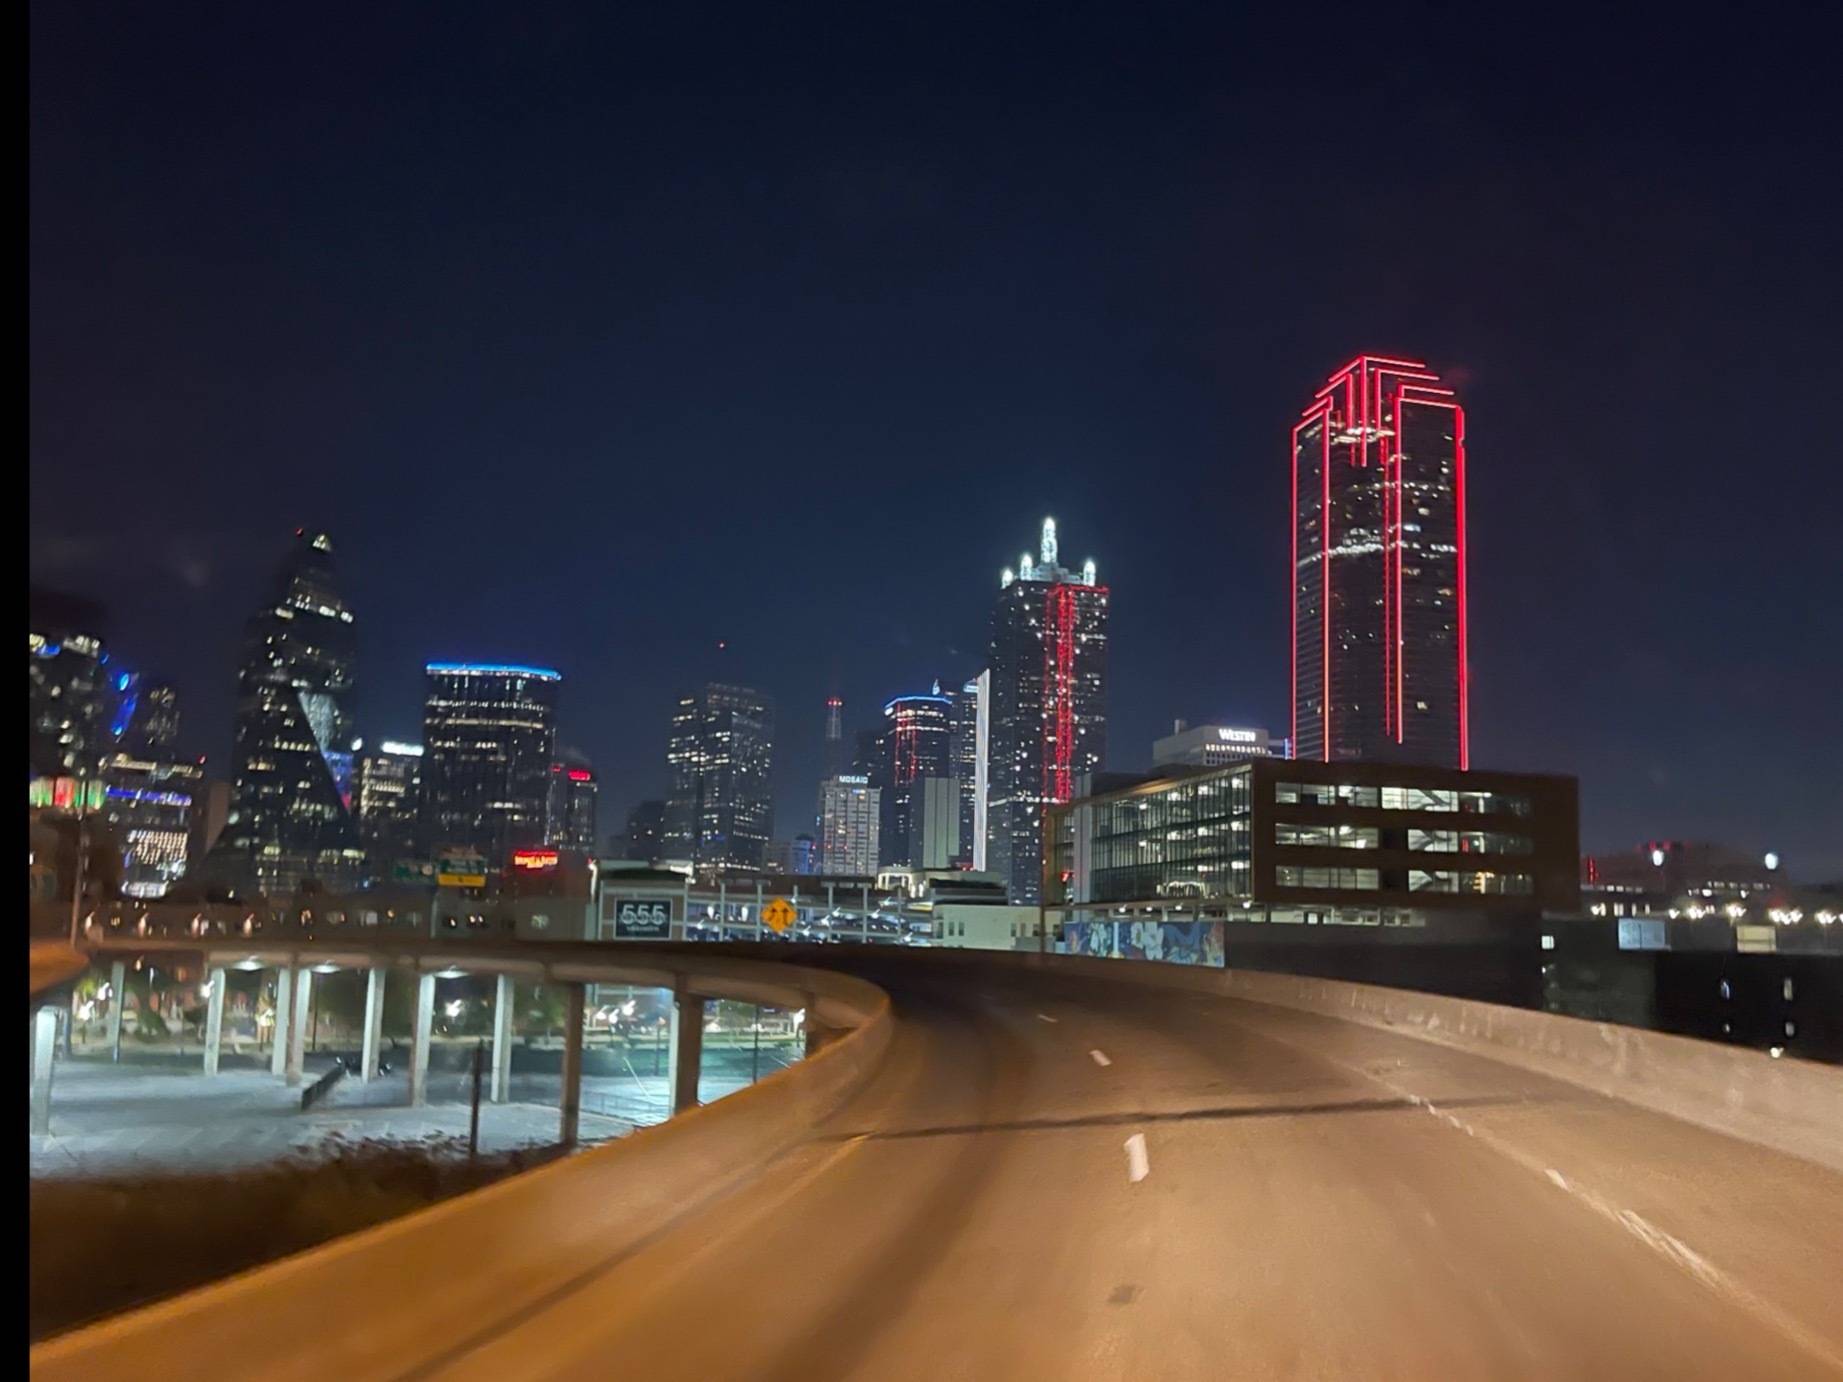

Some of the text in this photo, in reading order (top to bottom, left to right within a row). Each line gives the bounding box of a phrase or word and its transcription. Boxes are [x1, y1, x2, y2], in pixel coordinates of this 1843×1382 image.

[1218, 728, 1256, 742] WESTIN
[838, 775, 869, 785] MOSAIC
[620, 903, 666, 926] 555
